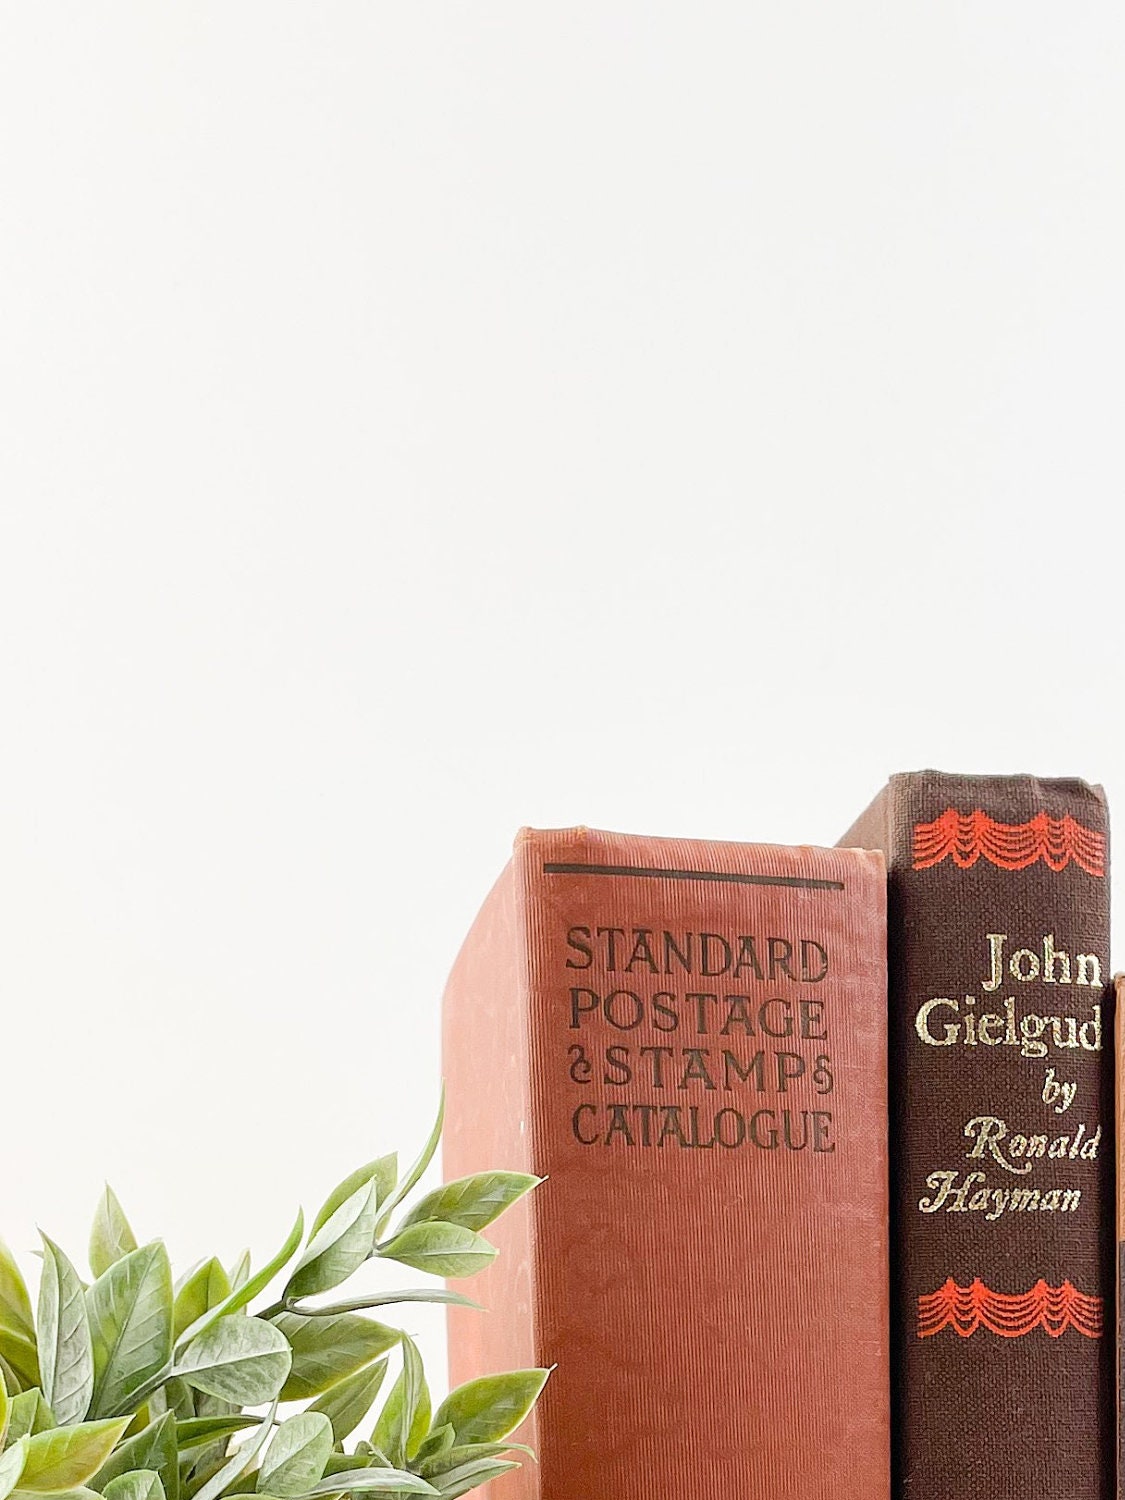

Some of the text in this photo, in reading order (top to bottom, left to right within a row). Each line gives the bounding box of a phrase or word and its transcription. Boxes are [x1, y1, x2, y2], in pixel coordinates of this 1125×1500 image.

[566, 927, 828, 983] STANDARD
[982, 933, 1103, 991] John
[569, 988, 828, 1041] POSTAGE
[914, 996, 1102, 1058] Gielgud
[1041, 1067, 1077, 1113] by
[572, 1104, 836, 1153] CATALOGUE
[963, 1116, 1101, 1174] Ronald
[918, 1171, 1081, 1220] Hayman
